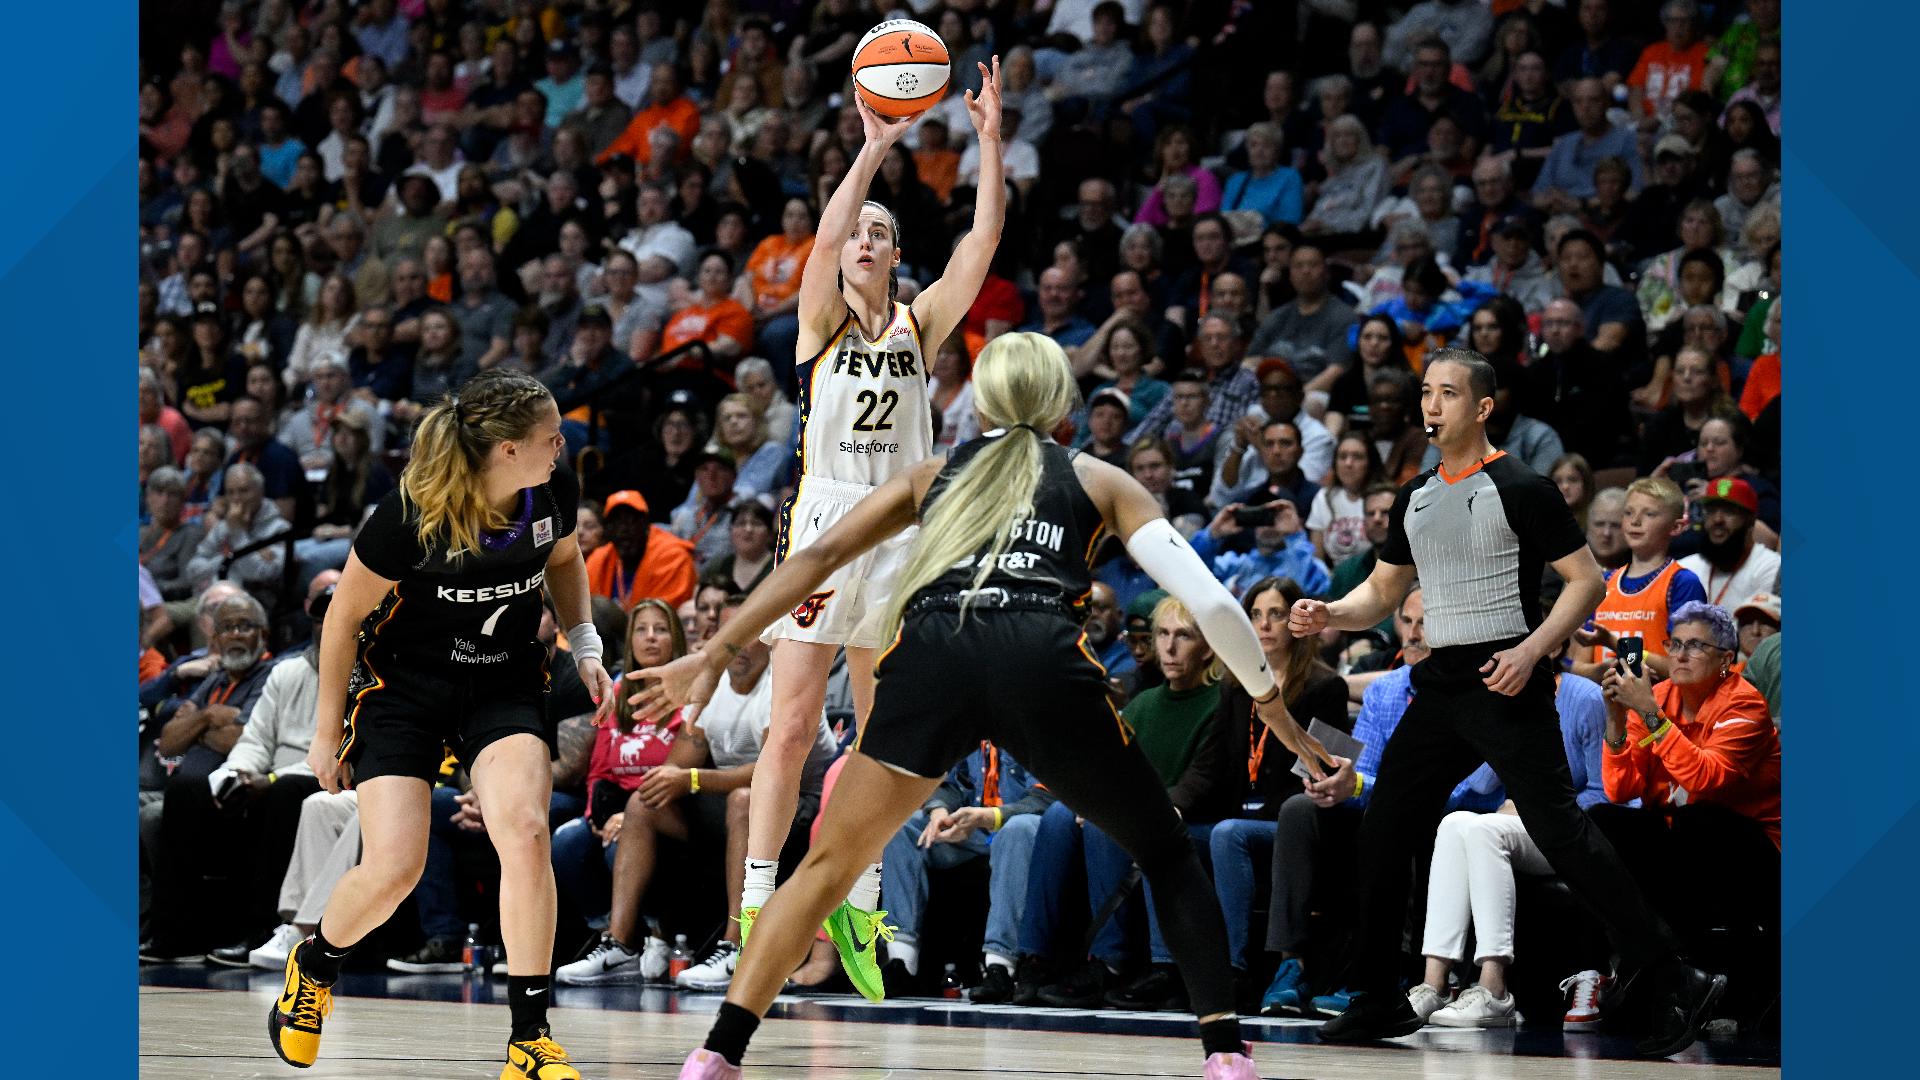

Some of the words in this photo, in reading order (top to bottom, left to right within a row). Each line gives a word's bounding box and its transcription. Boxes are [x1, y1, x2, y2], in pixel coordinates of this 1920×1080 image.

[833, 350, 918, 379] FEVER
[852, 389, 900, 432] 22
[839, 440, 899, 456] salesforce
[996, 517, 1065, 552] GTON
[438, 569, 545, 602] KEESUS
[1596, 610, 1656, 620] CONNECTICUT
[454, 638, 476, 652] Yale
[451, 650, 508, 663] NewHaven
